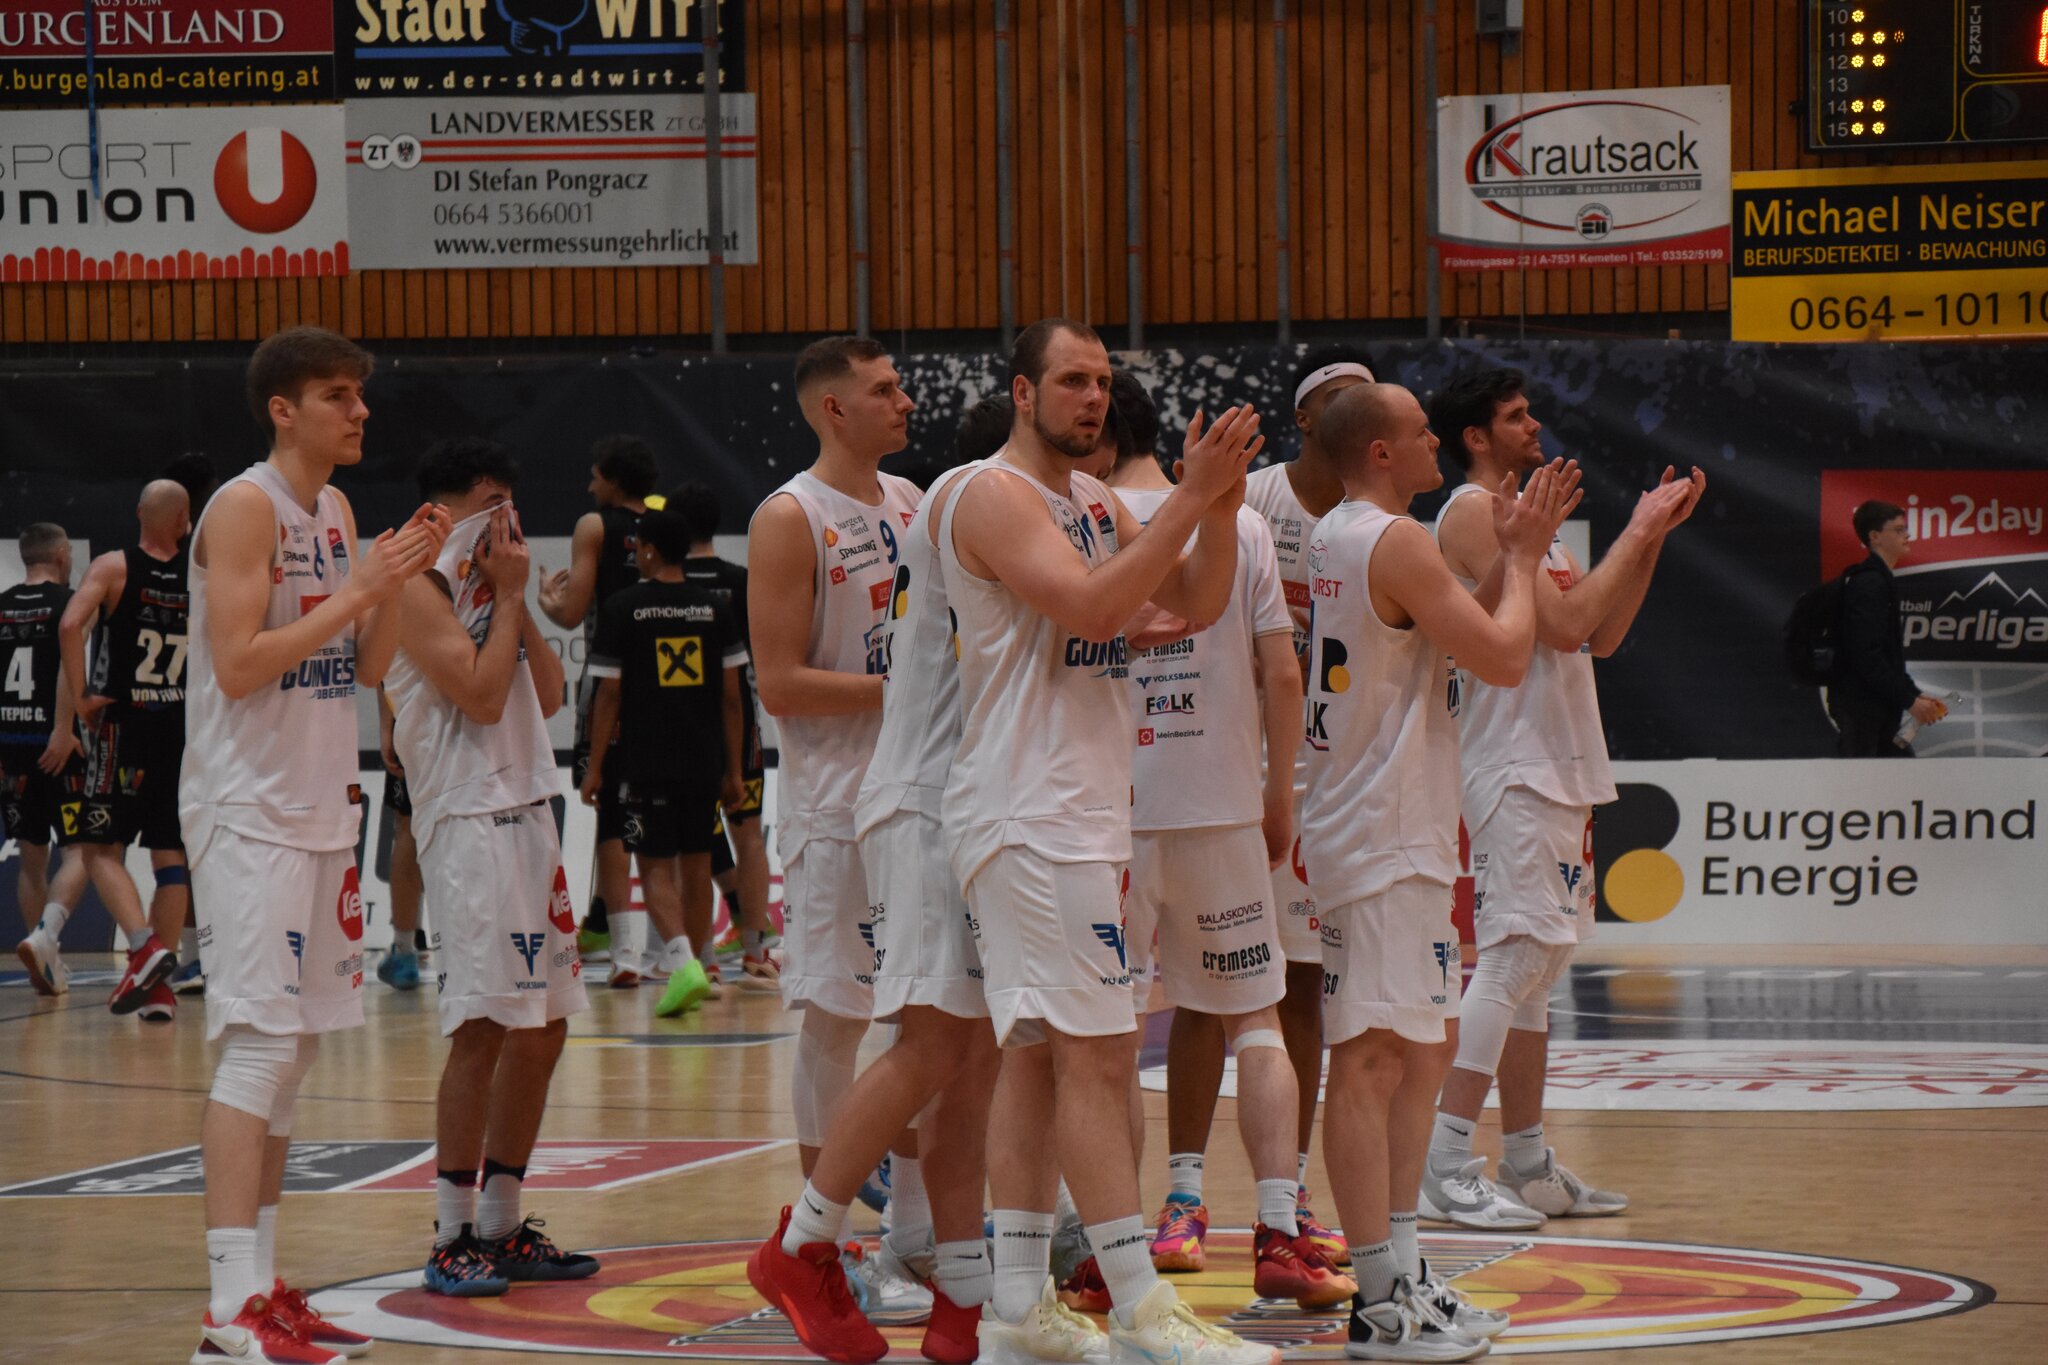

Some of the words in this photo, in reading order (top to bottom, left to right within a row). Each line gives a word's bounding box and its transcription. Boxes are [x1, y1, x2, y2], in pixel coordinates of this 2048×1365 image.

[1828, 10, 1848, 24] 10
[1828, 32, 1847, 46] 11
[1828, 55, 1848, 70] 12
[0, 65, 320, 95] .burgenland-catering.at
[1828, 78, 1848, 92] 13
[1828, 101, 1848, 115] 14
[430, 109, 655, 135] LANDVERMESSER
[1828, 123, 1848, 137] 15
[367, 145, 389, 160] ZT
[1484, 104, 1699, 177] Krautsack
[0, 143, 191, 180] PORT
[434, 171, 460, 192] DI
[468, 168, 538, 192] Stefan
[546, 169, 649, 197] Pongracz
[1488, 185, 1560, 197] Architektur
[1576, 182, 1650, 195] Baumeister
[1659, 180, 1696, 191] GmbH
[434, 203, 489, 225] 0664
[497, 202, 594, 225] 5366001
[1743, 195, 1900, 236] Michael
[1919, 193, 2046, 231] Neiser
[434, 229, 739, 260] www.vermessungehrlichat
[1743, 244, 1899, 266] BERUFSDETEKTEI
[1919, 239, 2046, 261] BEWACHUNG
[1905, 494, 2043, 542] in2day
[838, 540, 877, 560] SPALDING
[879, 519, 898, 564] 9
[1900, 609, 2048, 650] perliga
[134, 628, 188, 686] 27
[4, 646, 36, 701] 4
[1153, 672, 1201, 683] VOLKSBANK
[1, 707, 35, 722] TEPIC
[1156, 729, 1204, 739] MeinBezirk.at
[1705, 800, 2036, 851] Burgenland
[1702, 855, 1918, 906] Energie
[1197, 901, 1263, 924] BALASKOVICS
[1202, 942, 1270, 972] cremesso
